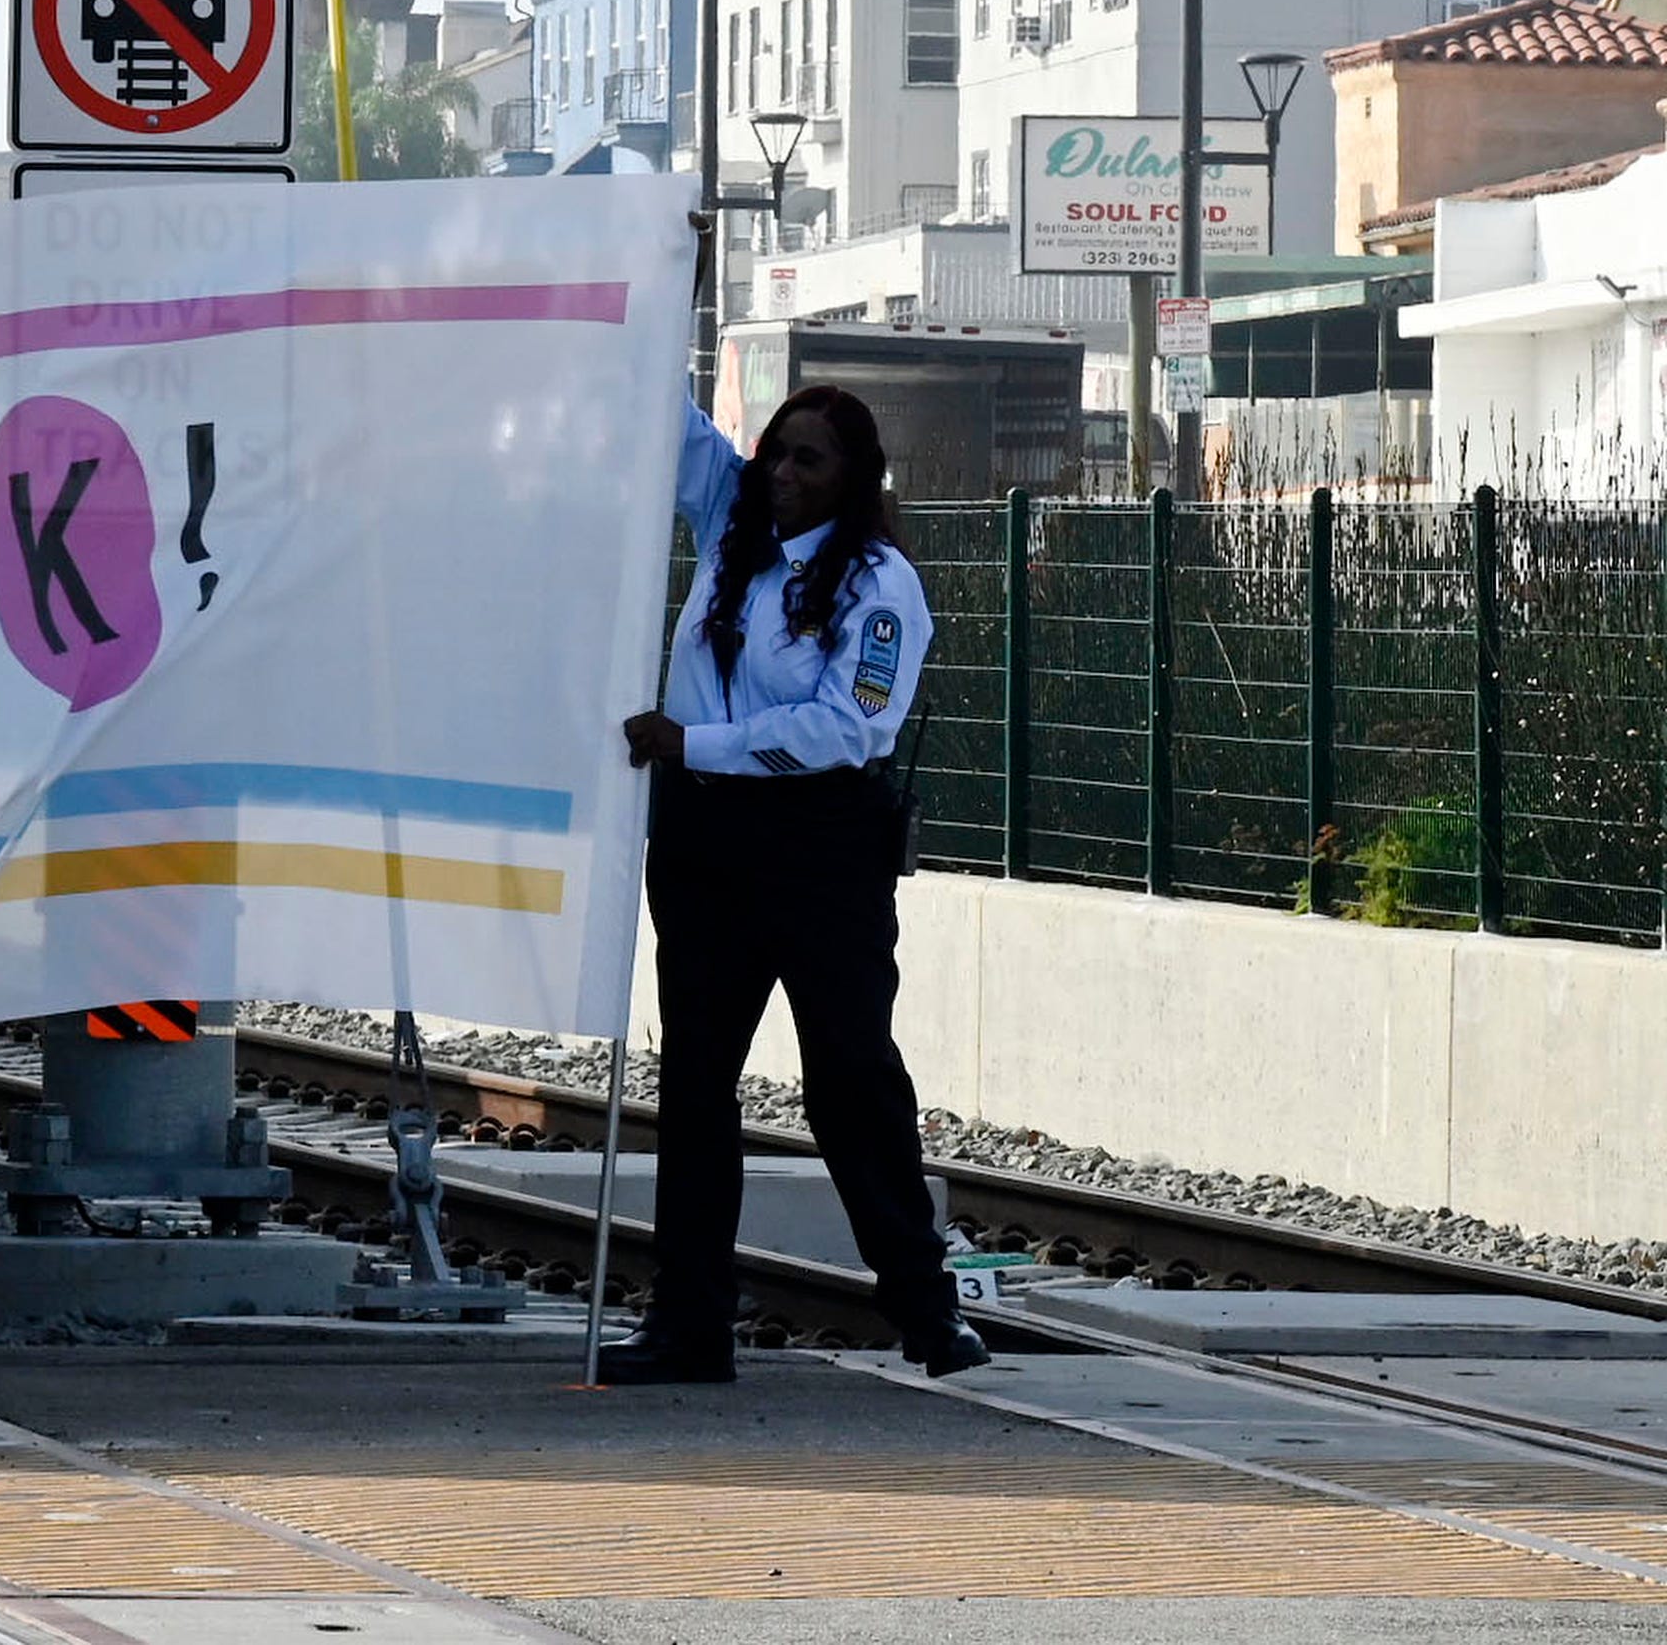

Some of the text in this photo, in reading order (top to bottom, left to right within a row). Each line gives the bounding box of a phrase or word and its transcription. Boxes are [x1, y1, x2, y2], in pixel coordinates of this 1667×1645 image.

[1160, 182, 1253, 199] Crshaw
[1066, 202, 1228, 223] SOUL FOD
[1081, 250, 1177, 266] (323) 296-3
[8, 457, 121, 656] K
